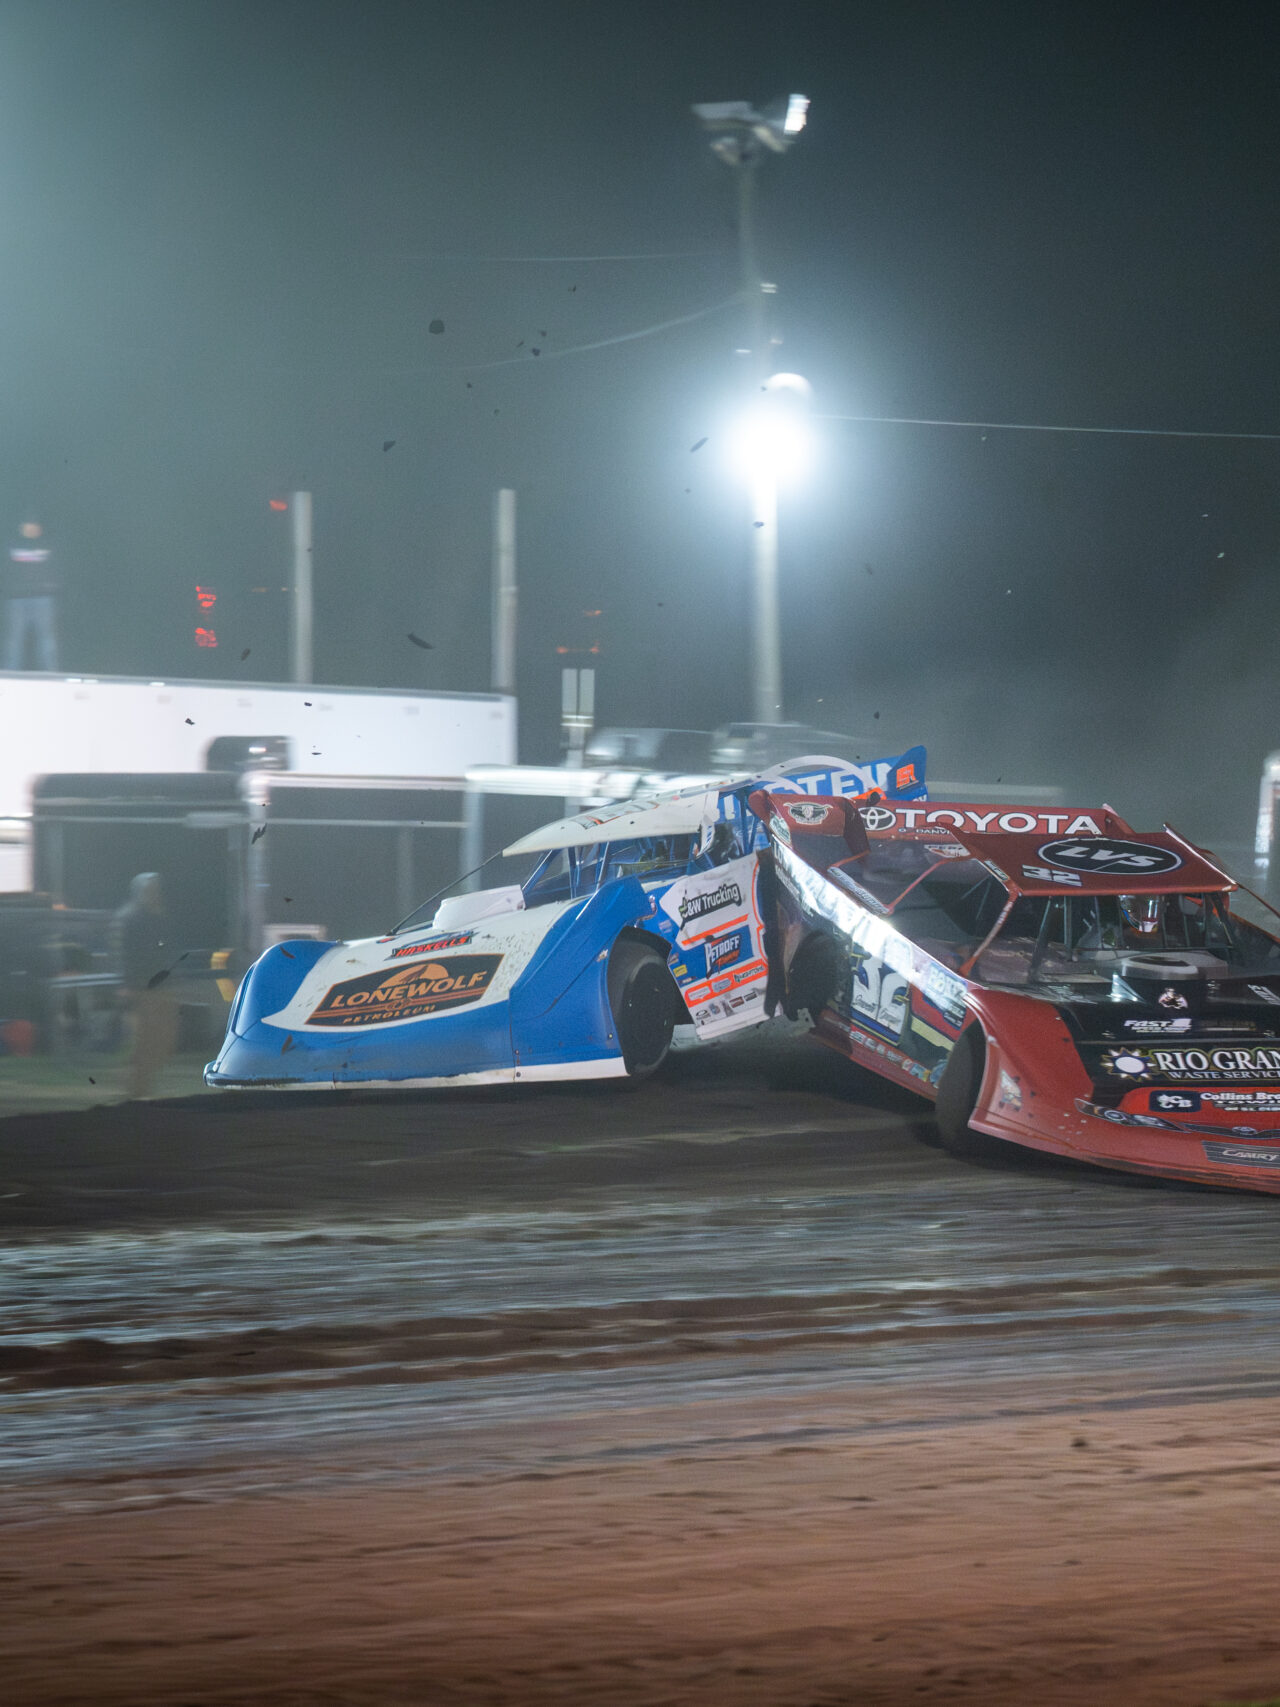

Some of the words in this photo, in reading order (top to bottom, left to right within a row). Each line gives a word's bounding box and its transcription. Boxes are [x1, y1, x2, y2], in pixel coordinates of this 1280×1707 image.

[895, 808, 1103, 835] TOYOTA
[1055, 846, 1164, 867] LVS
[1022, 864, 1082, 887] 32
[701, 884, 740, 911] Trucking
[395, 935, 471, 958] HASKELLS
[330, 970, 488, 1008] LONEWOLF
[343, 1004, 436, 1025] PETROLEUM
[1124, 1019, 1172, 1027] FAST
[1153, 1050, 1208, 1071] RIO
[1168, 1071, 1222, 1079] WASTE
[1200, 1092, 1253, 1101] Collins
[1222, 1149, 1280, 1162] CAMRY
